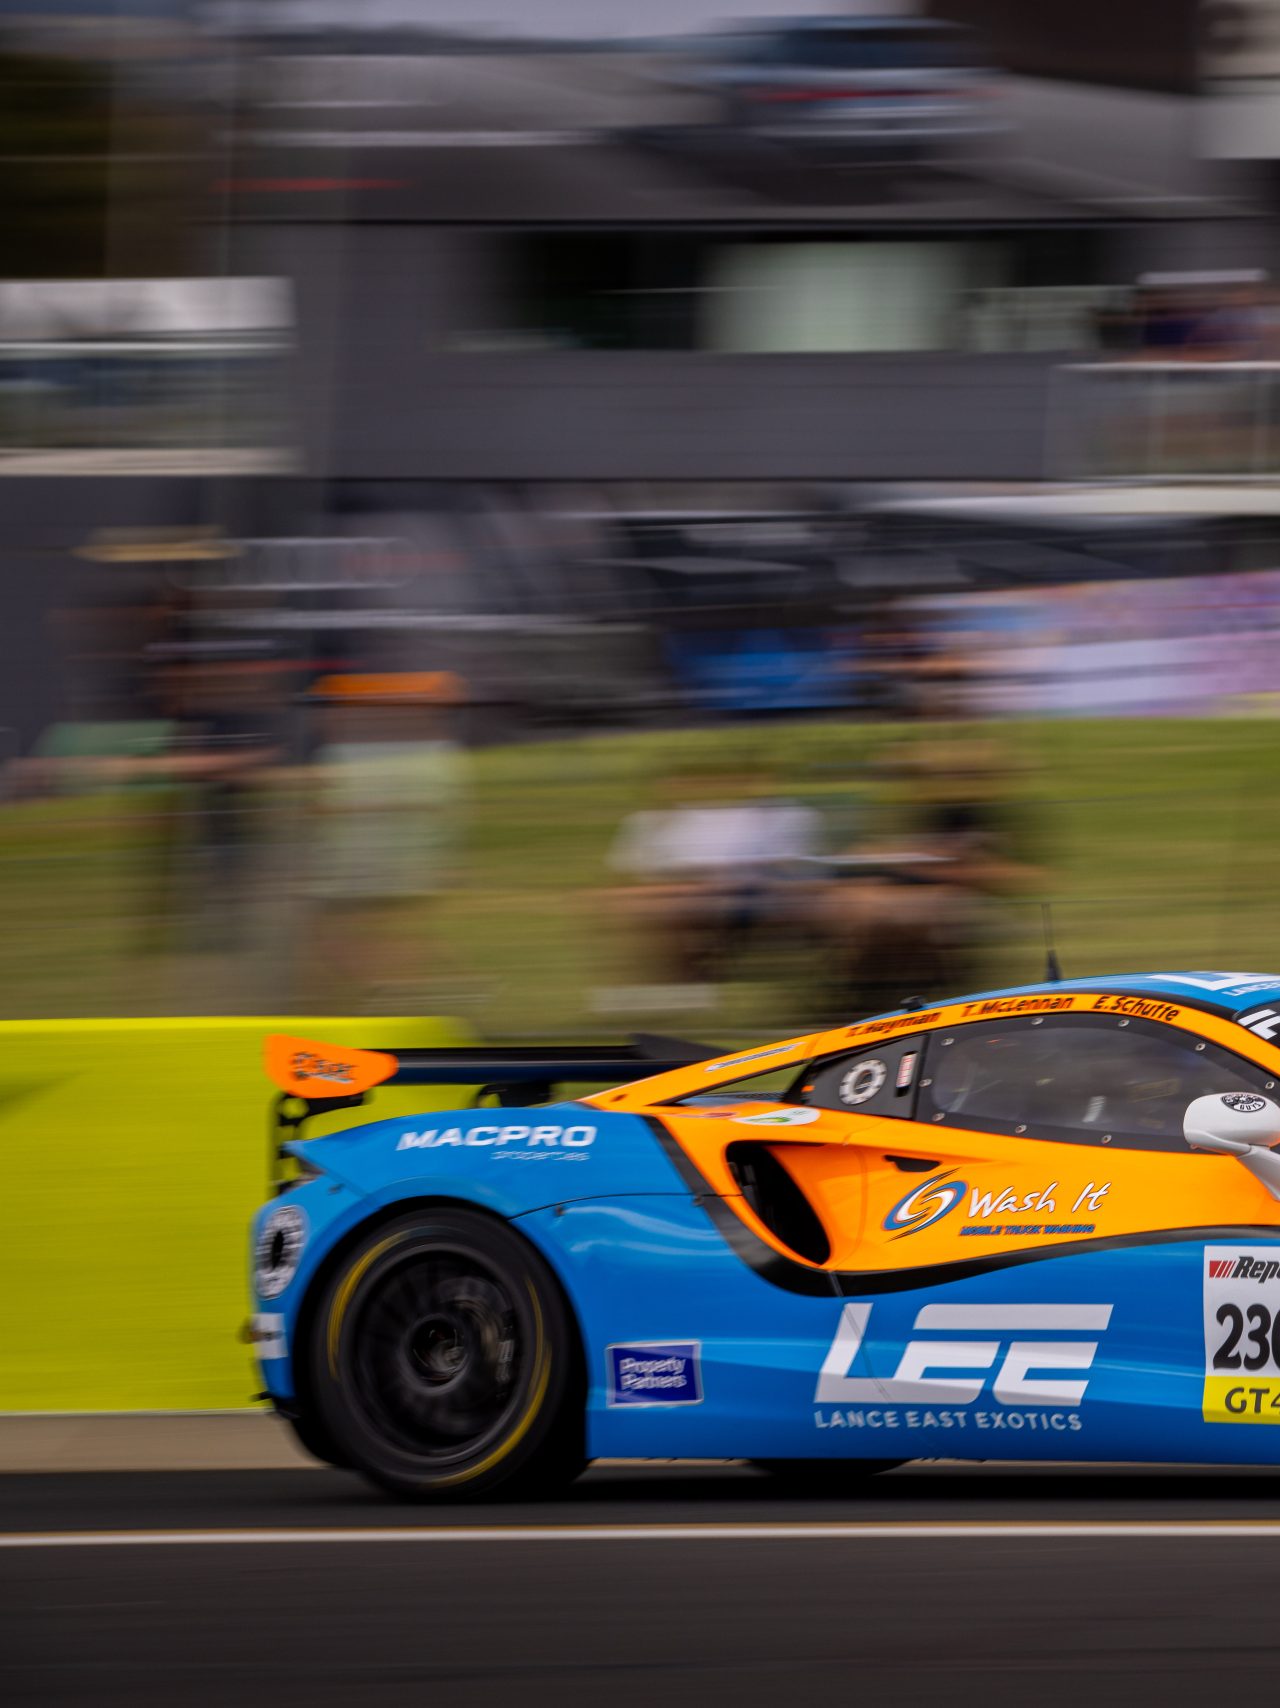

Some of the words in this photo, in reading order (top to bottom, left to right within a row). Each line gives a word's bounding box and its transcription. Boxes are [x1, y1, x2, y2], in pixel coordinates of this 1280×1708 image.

[396, 1125, 597, 1151] MACPRO
[968, 1181, 1060, 1218] Wash
[1071, 1181, 1112, 1213] It
[959, 1224, 1002, 1237] MOBILE
[1004, 1224, 1042, 1235] TRUCK
[1043, 1223, 1096, 1234] WASHING
[814, 1302, 1114, 1407] LEE
[620, 1356, 686, 1376] Property
[621, 1373, 687, 1391] Partners
[814, 1410, 900, 1429] LANCE
[906, 1411, 968, 1428] EAST
[975, 1411, 1083, 1431] EXOTICS
